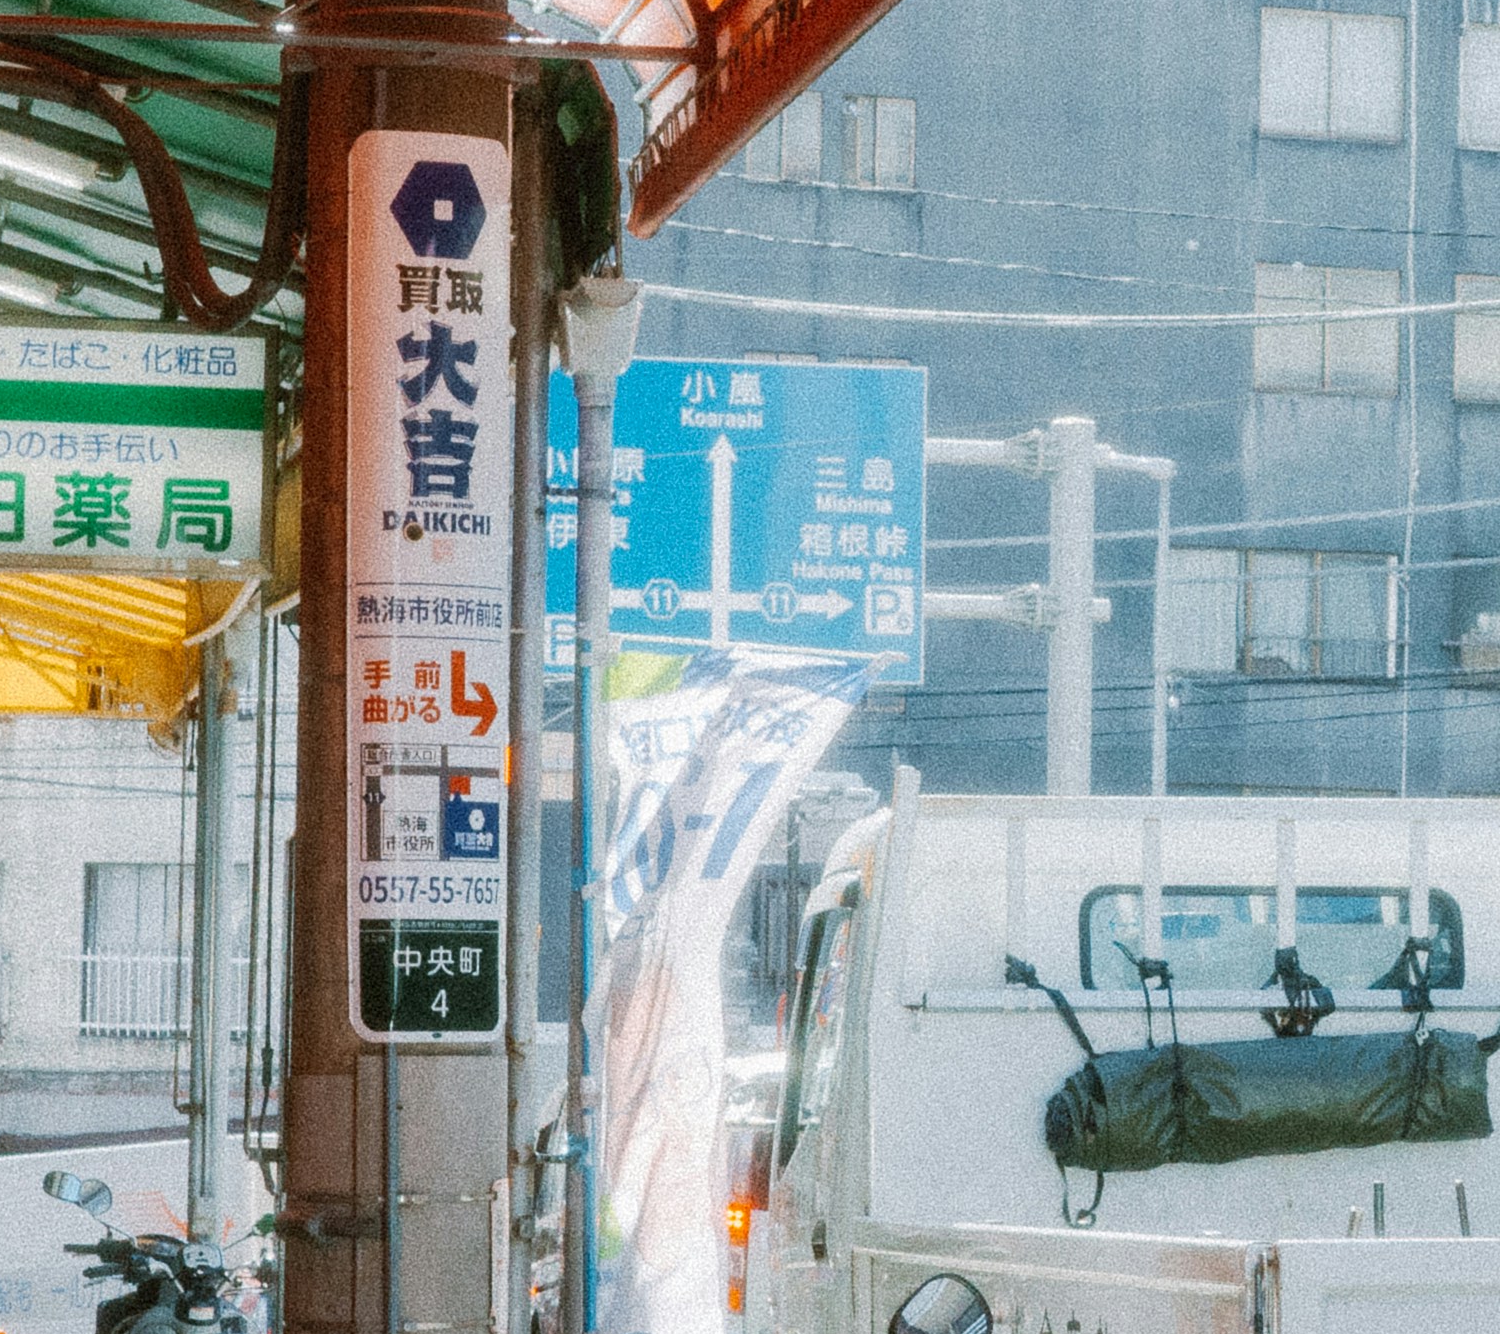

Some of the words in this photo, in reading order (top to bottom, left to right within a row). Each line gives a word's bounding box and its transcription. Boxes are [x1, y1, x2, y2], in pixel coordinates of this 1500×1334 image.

[396, 264, 483, 315] 買取
[396, 320, 480, 499] 大吉
[816, 456, 894, 492] 三島
[382, 510, 490, 535] DAIKICHI
[800, 524, 909, 558] 箱根峠
[651, 589, 672, 610] 11
[769, 591, 790, 612] 11
[363, 660, 441, 689] 手前
[363, 695, 441, 724] 曲がる
[393, 945, 483, 978] 中央町
[431, 989, 449, 1018] 4
